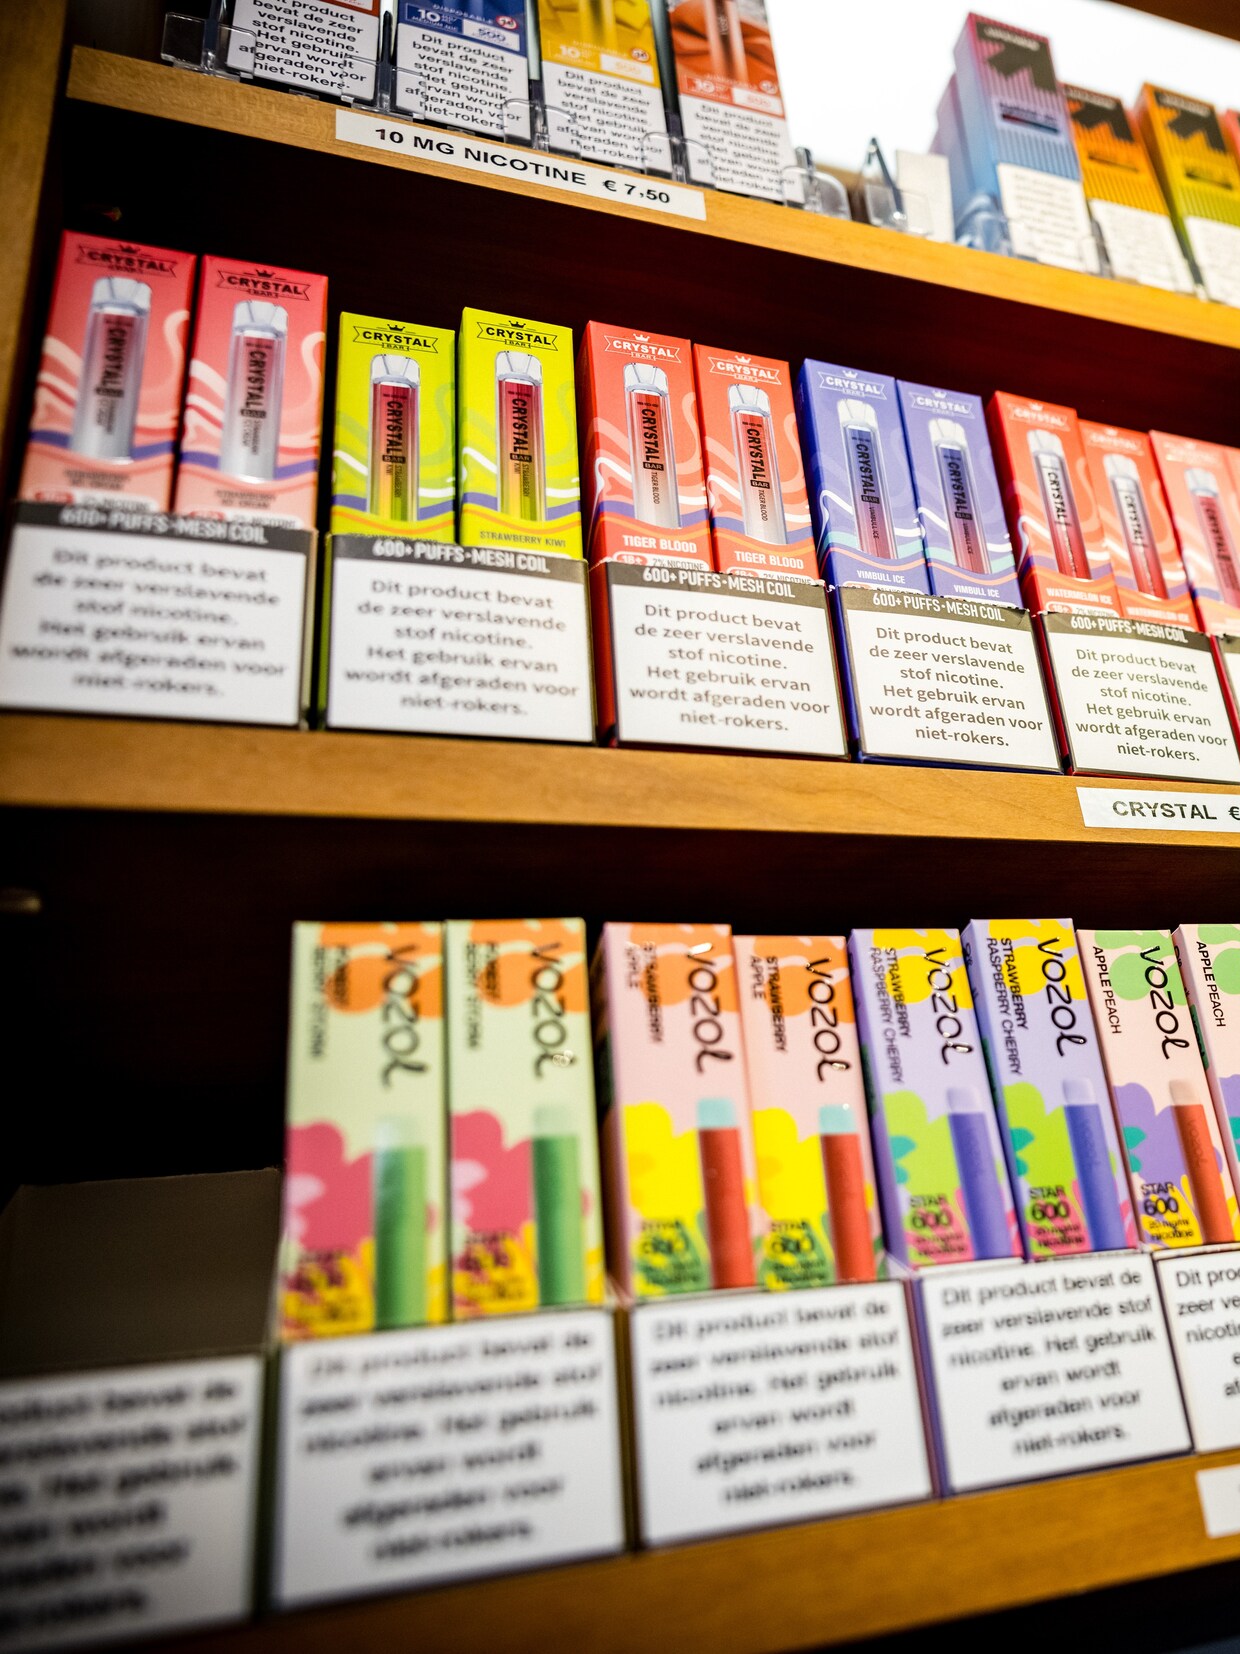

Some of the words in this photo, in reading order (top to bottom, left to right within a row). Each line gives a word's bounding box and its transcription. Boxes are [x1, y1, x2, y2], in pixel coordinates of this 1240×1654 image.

[258, 10, 356, 43] verslavende
[303, 10, 323, 24] de
[328, 19, 364, 35] zeer
[252, 19, 284, 35] stof
[290, 24, 359, 54] nicotine.
[375, 128, 403, 144] 10
[413, 136, 455, 155] MG
[464, 147, 587, 186] NICOTINE
[604, 180, 617, 192] €
[624, 182, 671, 204] 7,50
[363, 330, 432, 348] CRYSTAL
[486, 326, 552, 346] CRYSTAL
[613, 339, 675, 358] CRYSTAL
[717, 361, 775, 380] CRYSTAL
[826, 376, 880, 394] CRYSTAL
[641, 408, 659, 464] CRYSTAL
[480, 531, 542, 546] STRAWBERRY
[545, 537, 566, 548] KIWI
[623, 535, 656, 549] TIGER
[660, 538, 697, 553] BLOOD
[734, 550, 766, 565] TIGER
[769, 554, 804, 569] BLOOD
[643, 567, 677, 583] 600+
[767, 582, 795, 598] COIL
[857, 570, 891, 582] VIMBULL
[893, 573, 905, 584] ICE
[954, 585, 985, 596] VIMBULL
[987, 588, 1000, 598] ICE
[873, 593, 902, 607] 600+
[980, 605, 1006, 622] COIL
[876, 627, 901, 641] Dit
[904, 631, 967, 649] product
[970, 637, 1013, 654] bevat
[869, 645, 889, 658] de
[894, 650, 928, 661] zeer
[931, 653, 1025, 674] verslavende
[900, 668, 931, 680] stof
[936, 670, 1003, 689] nicotine.
[883, 685, 913, 698] Het
[917, 688, 978, 704] gebruik
[981, 696, 1026, 710] ervan
[870, 704, 921, 718] wordt
[925, 707, 1005, 726] afgeraden
[1008, 718, 1043, 731] voor
[916, 727, 1009, 746] niet-rokers.
[1112, 800, 1217, 820] CRYSTAL
[885, 948, 912, 1039] STRAWBERRY
[1001, 938, 1028, 1030] STRAWBERRY
[1093, 946, 1111, 987] APPLE
[1103, 987, 1122, 1034] PEACH
[1196, 941, 1215, 982] APPLE
[1207, 983, 1226, 1027] PEACH
[870, 948, 895, 1024] RASPBERRY
[883, 1025, 905, 1083] CHERRY
[987, 938, 1010, 1016] RASPBERRY
[1001, 1020, 1022, 1076] CHERRY
